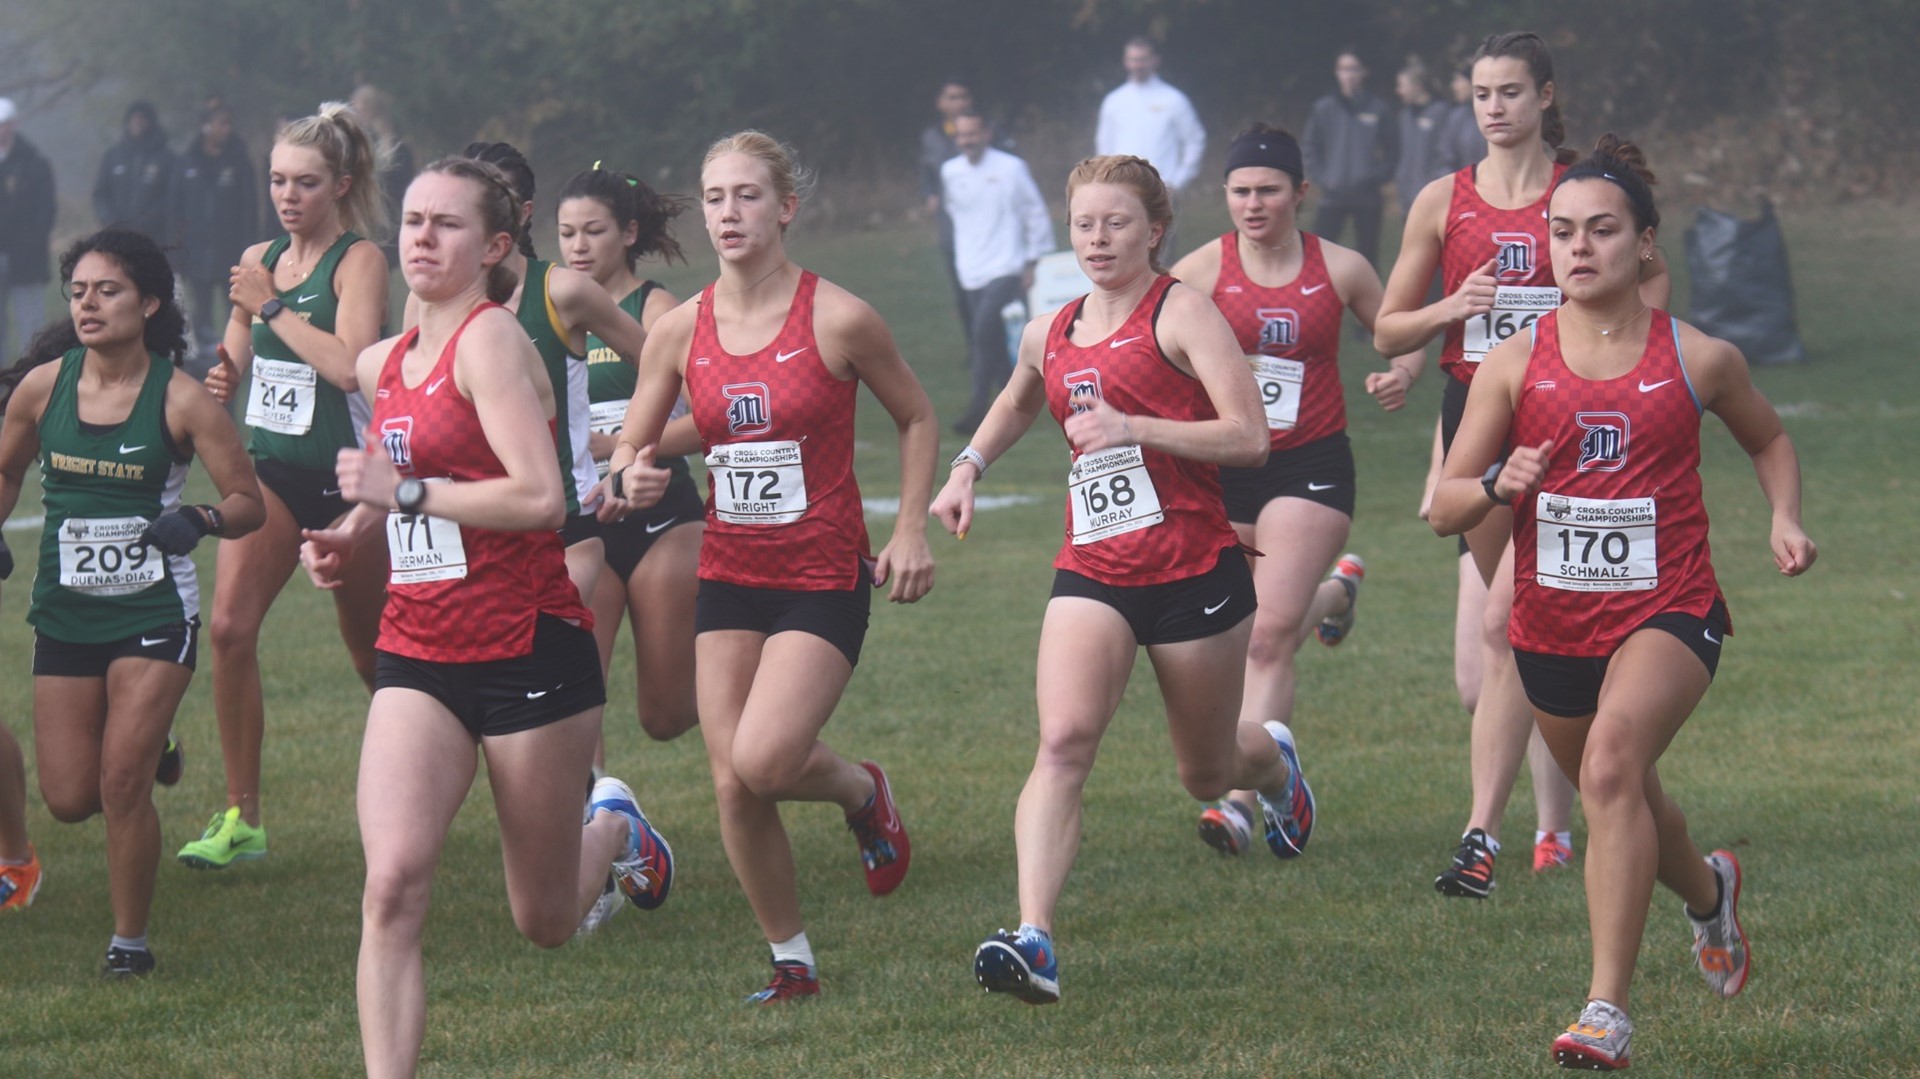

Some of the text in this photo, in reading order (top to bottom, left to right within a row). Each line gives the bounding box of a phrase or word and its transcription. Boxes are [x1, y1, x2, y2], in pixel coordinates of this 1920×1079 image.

[261, 382, 298, 412] 214
[733, 453, 799, 463] CHAMPIONSHIPS
[734, 447, 797, 457] CROSS COUNTRY
[1084, 449, 1138, 468] CROSS COUNTRY
[50, 452, 144, 480] WRIGHT STATE
[1084, 455, 1140, 476] CHAMPIONSHIPS
[726, 470, 782, 501] 172
[1081, 475, 1135, 516] 168
[733, 502, 777, 513] WRIGHT
[1089, 507, 1133, 528] MURRAY
[1577, 506, 1607, 515] CROSS
[1608, 506, 1651, 515] COUNTRY
[1575, 513, 1653, 523] CHAMPIONSHIPS
[94, 529, 145, 538] CHAMPIONS
[394, 514, 433, 552] 171
[1558, 528, 1630, 565] 170
[74, 542, 148, 573] 209
[71, 570, 154, 585] DUENAS-DIAZ
[1560, 564, 1630, 578] SCHMALZ
